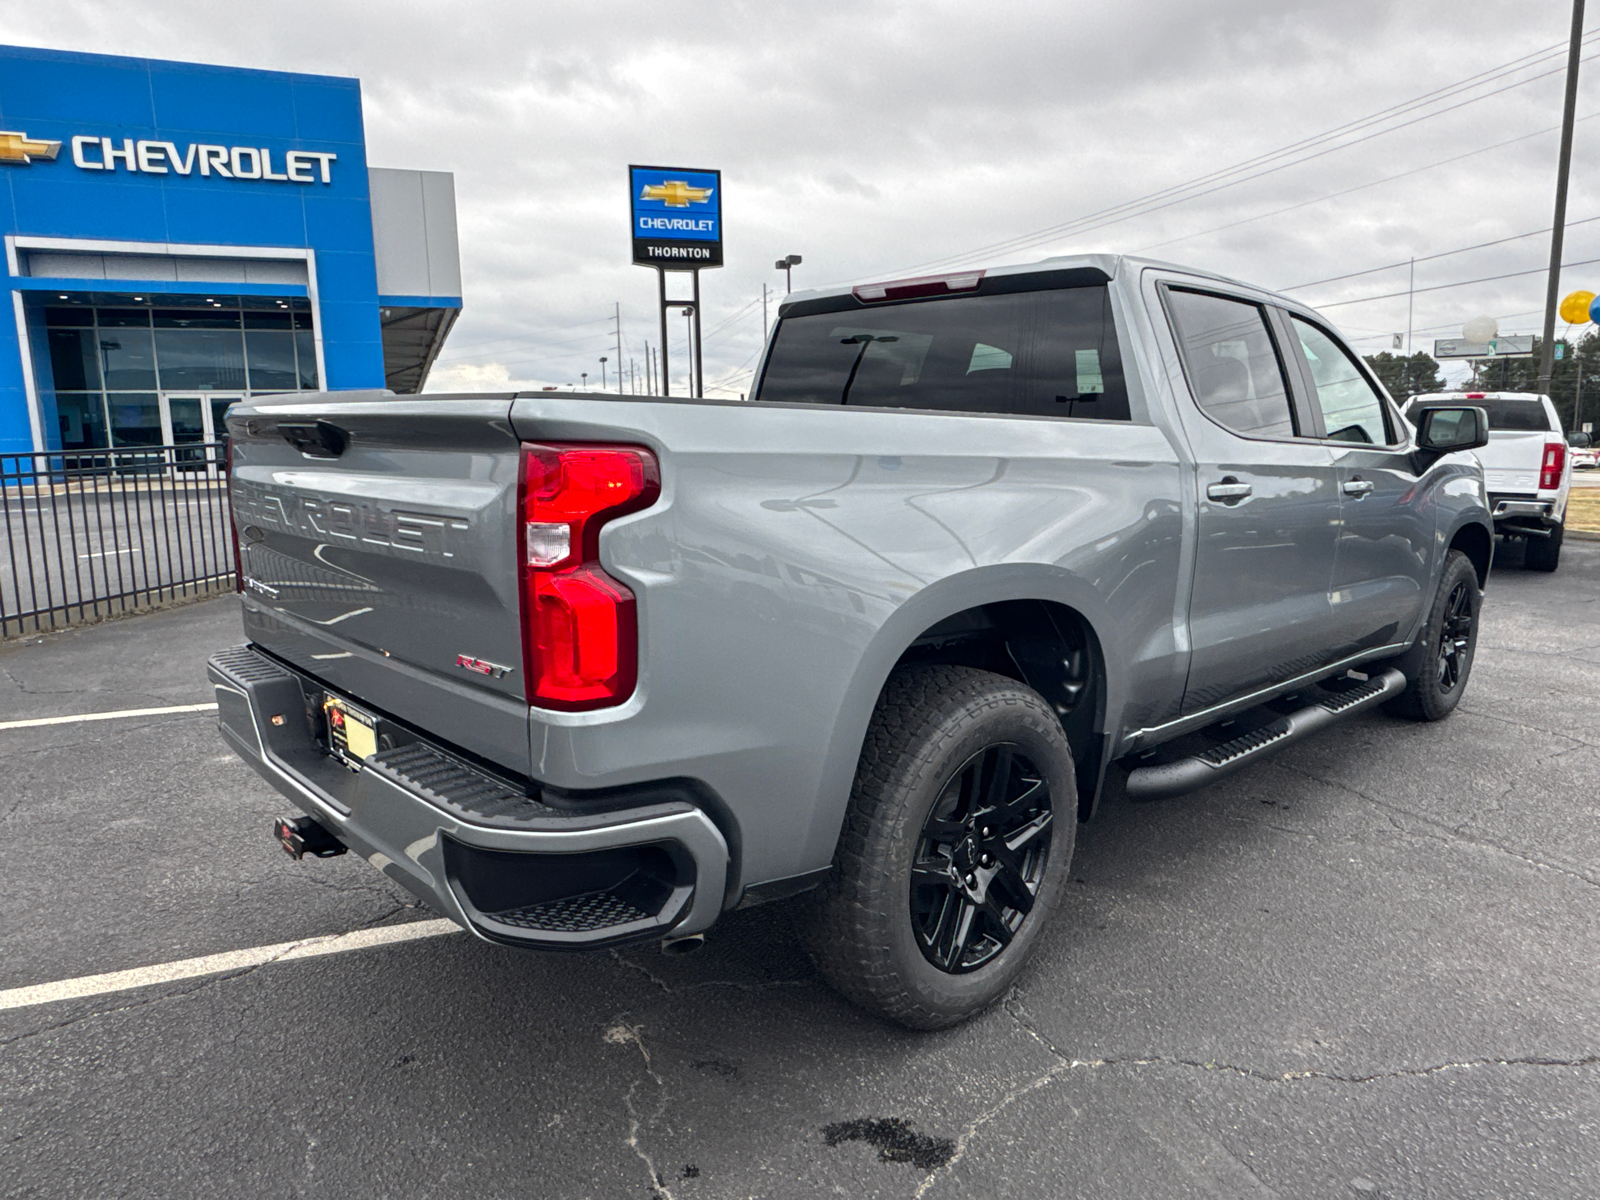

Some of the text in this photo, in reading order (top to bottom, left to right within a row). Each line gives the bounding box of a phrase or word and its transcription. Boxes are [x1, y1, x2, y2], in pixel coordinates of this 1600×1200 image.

[71, 135, 337, 184] CHEVROLET
[639, 217, 715, 231] CHEVROLET
[647, 246, 710, 258] THORNTON
[455, 653, 516, 679] RST
